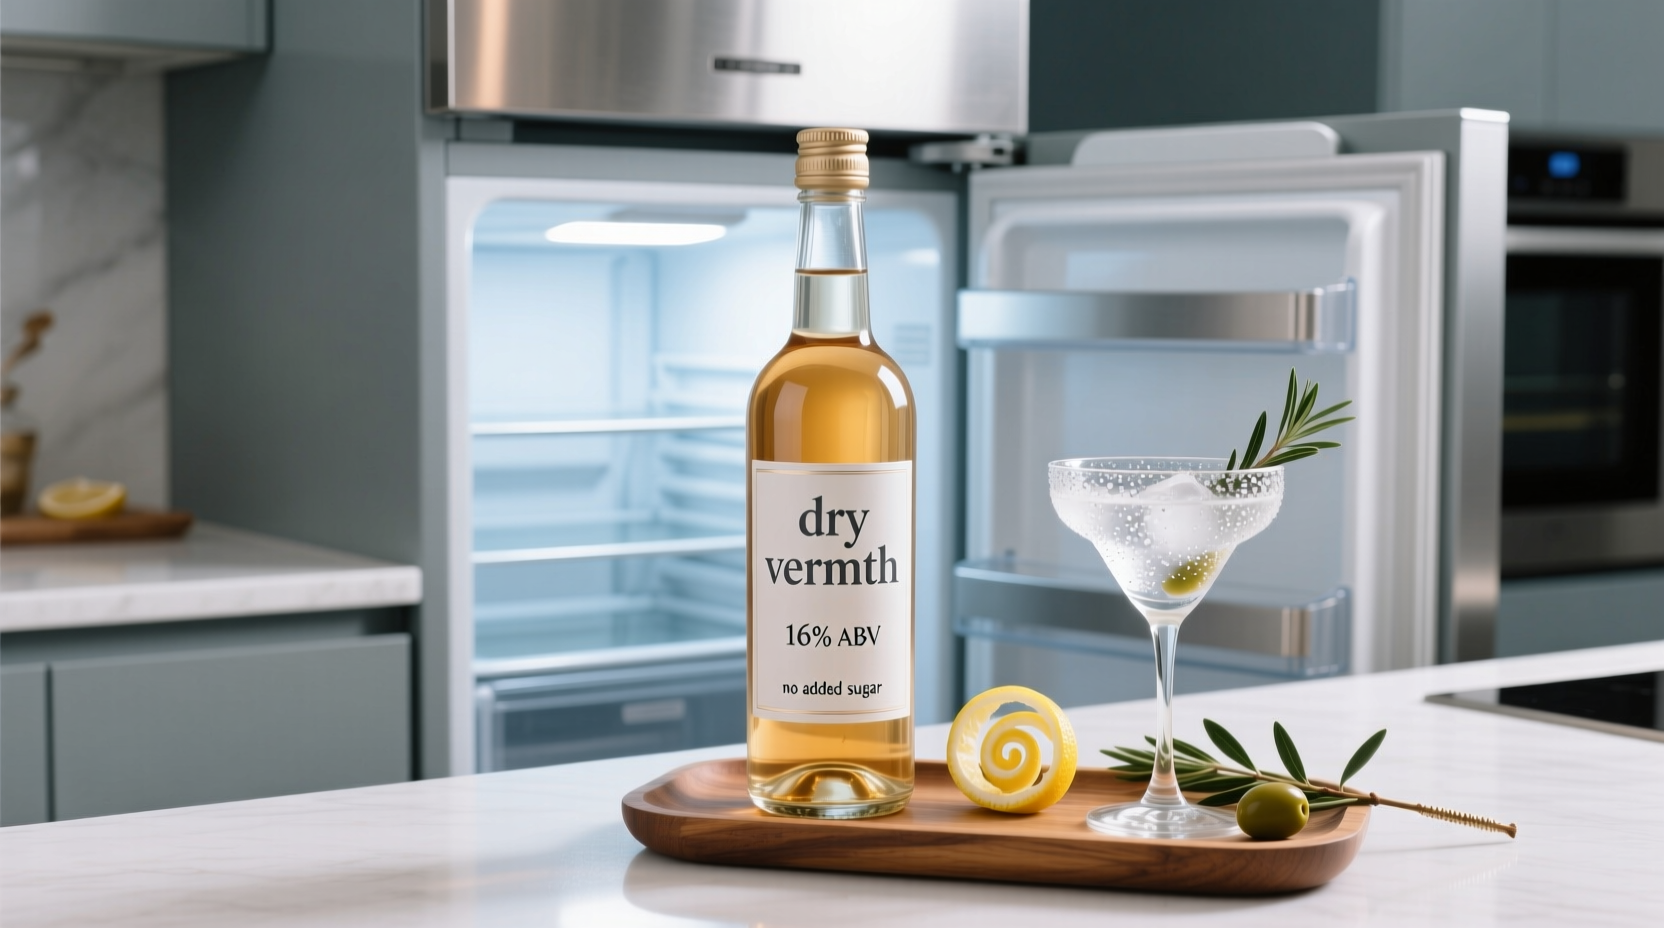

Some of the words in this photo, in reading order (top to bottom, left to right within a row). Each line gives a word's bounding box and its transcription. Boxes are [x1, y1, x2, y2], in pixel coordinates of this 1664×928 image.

[798, 495, 870, 549] dry
[764, 544, 899, 586] vermth
[785, 623, 832, 648] 16%
[837, 624, 881, 647] ABV
[782, 682, 799, 695] no
[802, 680, 843, 696] added
[847, 682, 883, 699] sugar
